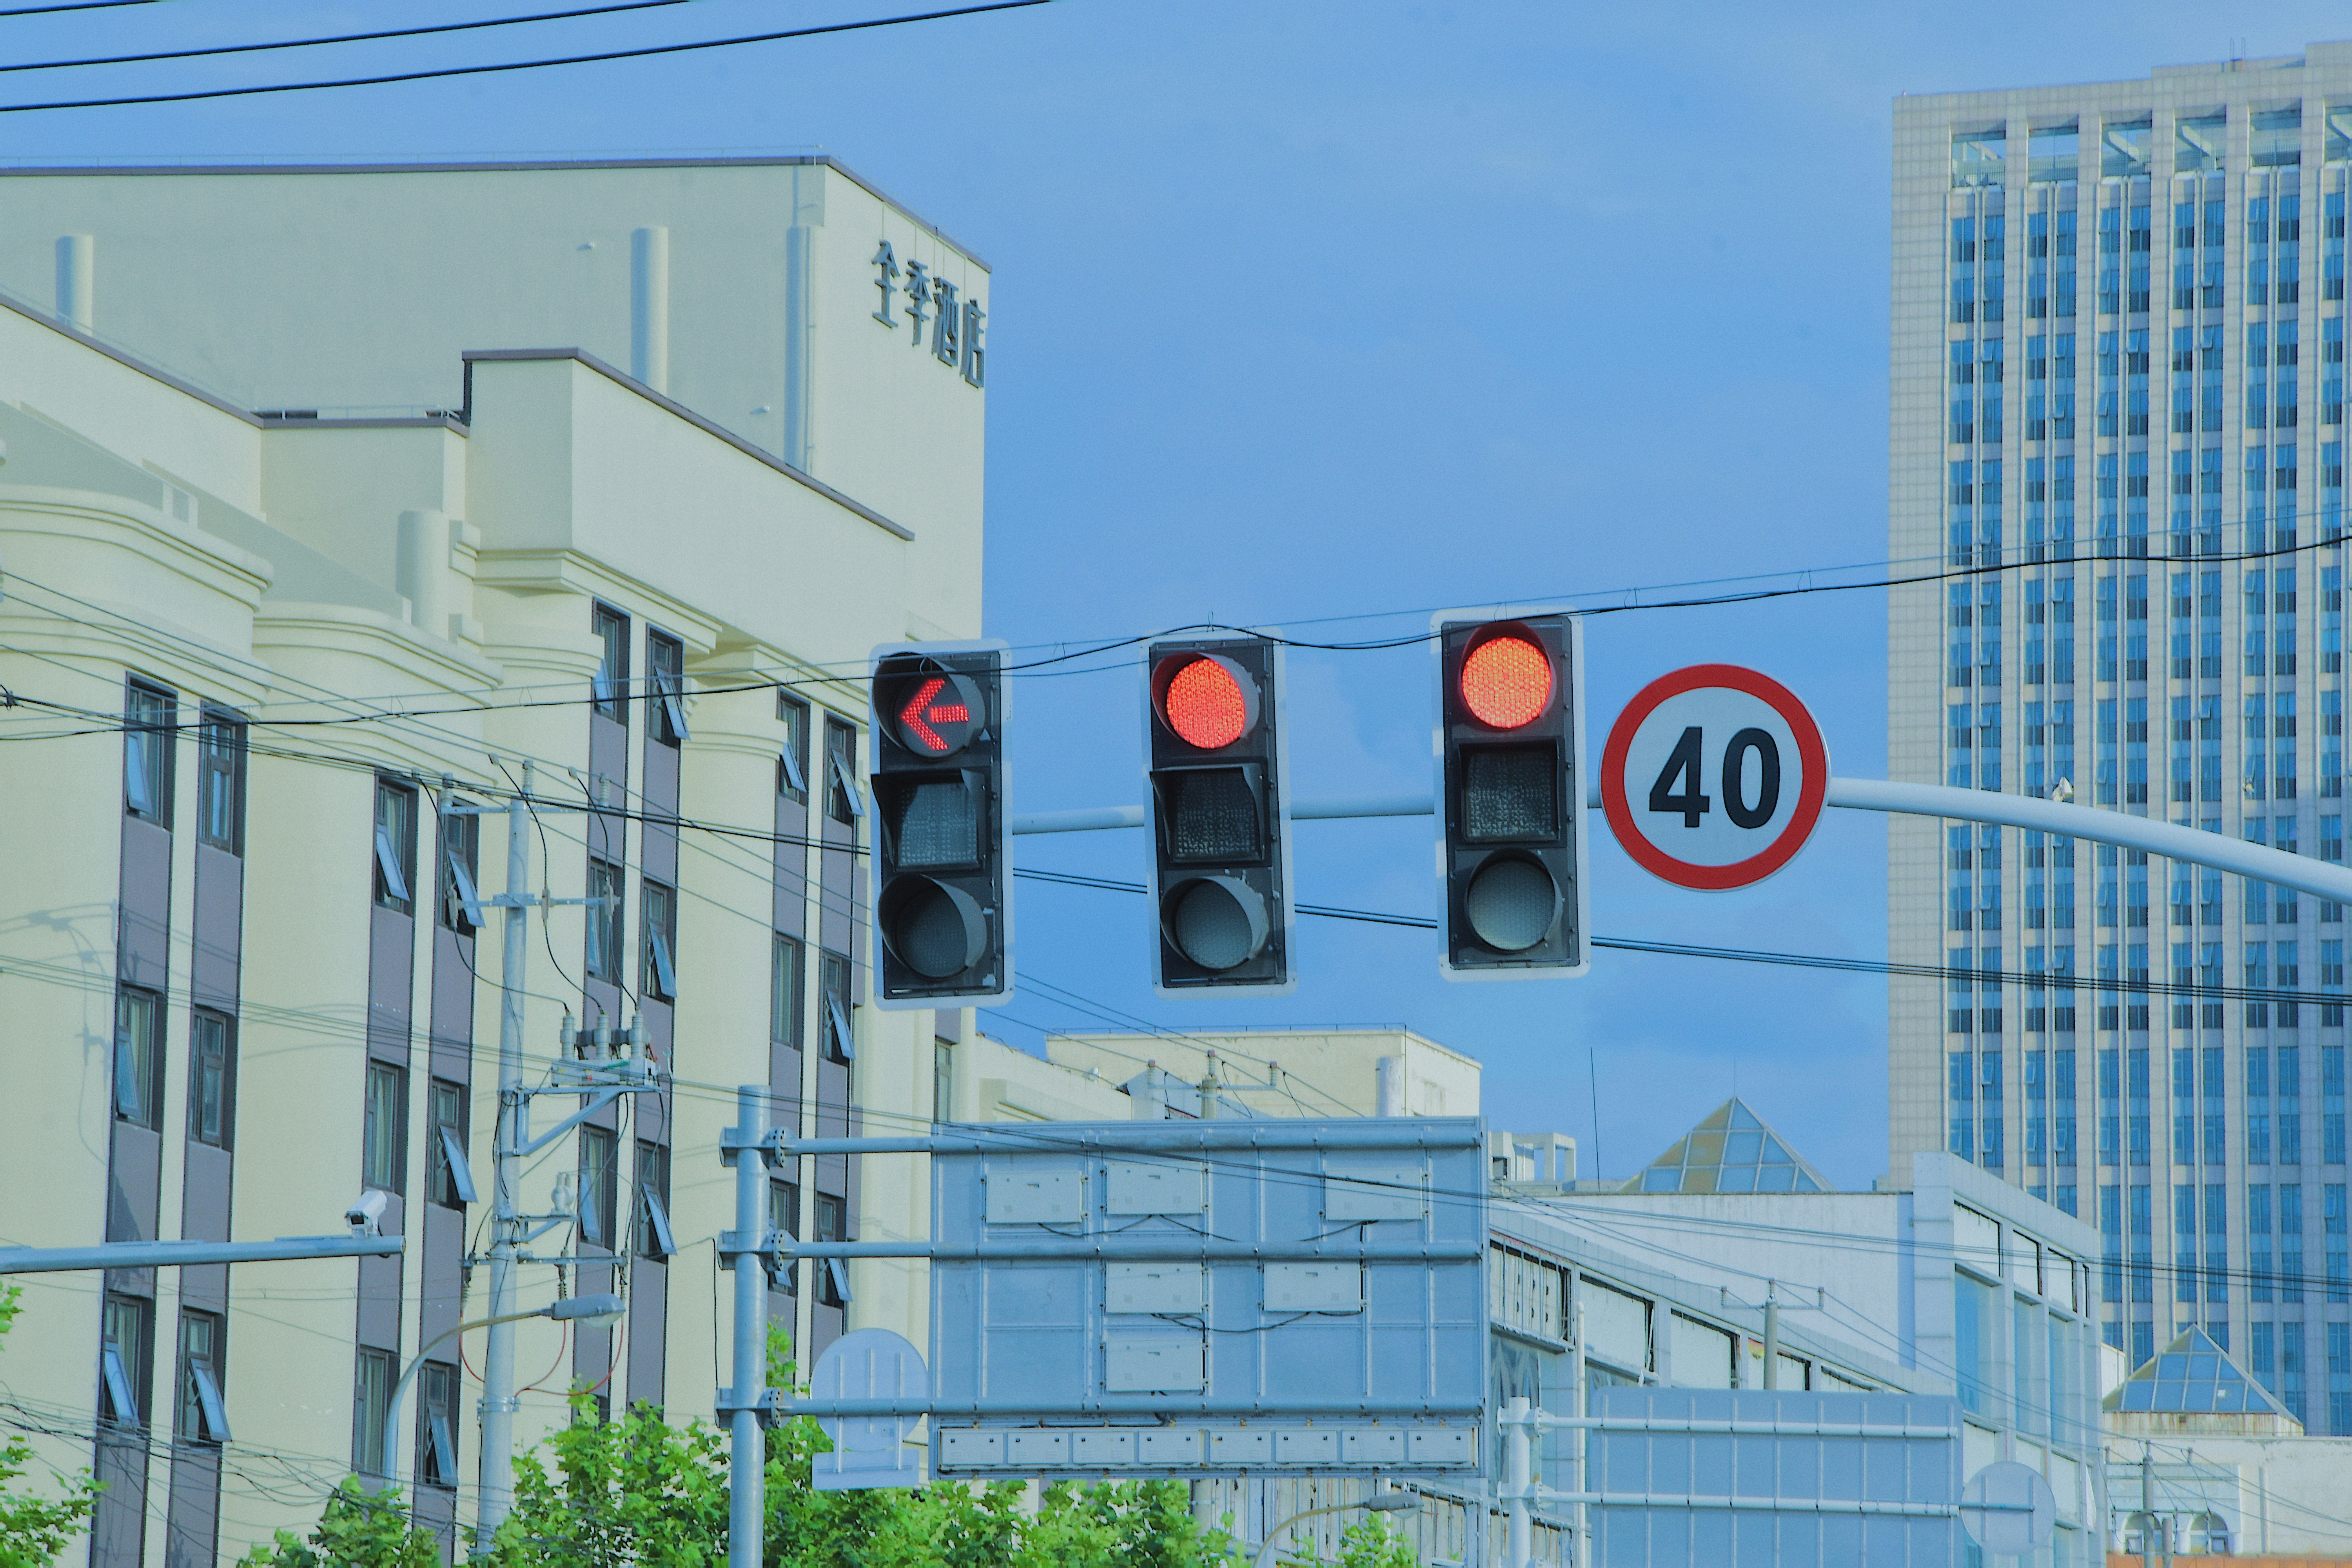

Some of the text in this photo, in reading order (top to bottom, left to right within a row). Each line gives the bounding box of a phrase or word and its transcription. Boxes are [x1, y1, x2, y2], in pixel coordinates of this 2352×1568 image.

[871, 239, 986, 389] 全季酒店
[1649, 726, 1780, 829] 40
